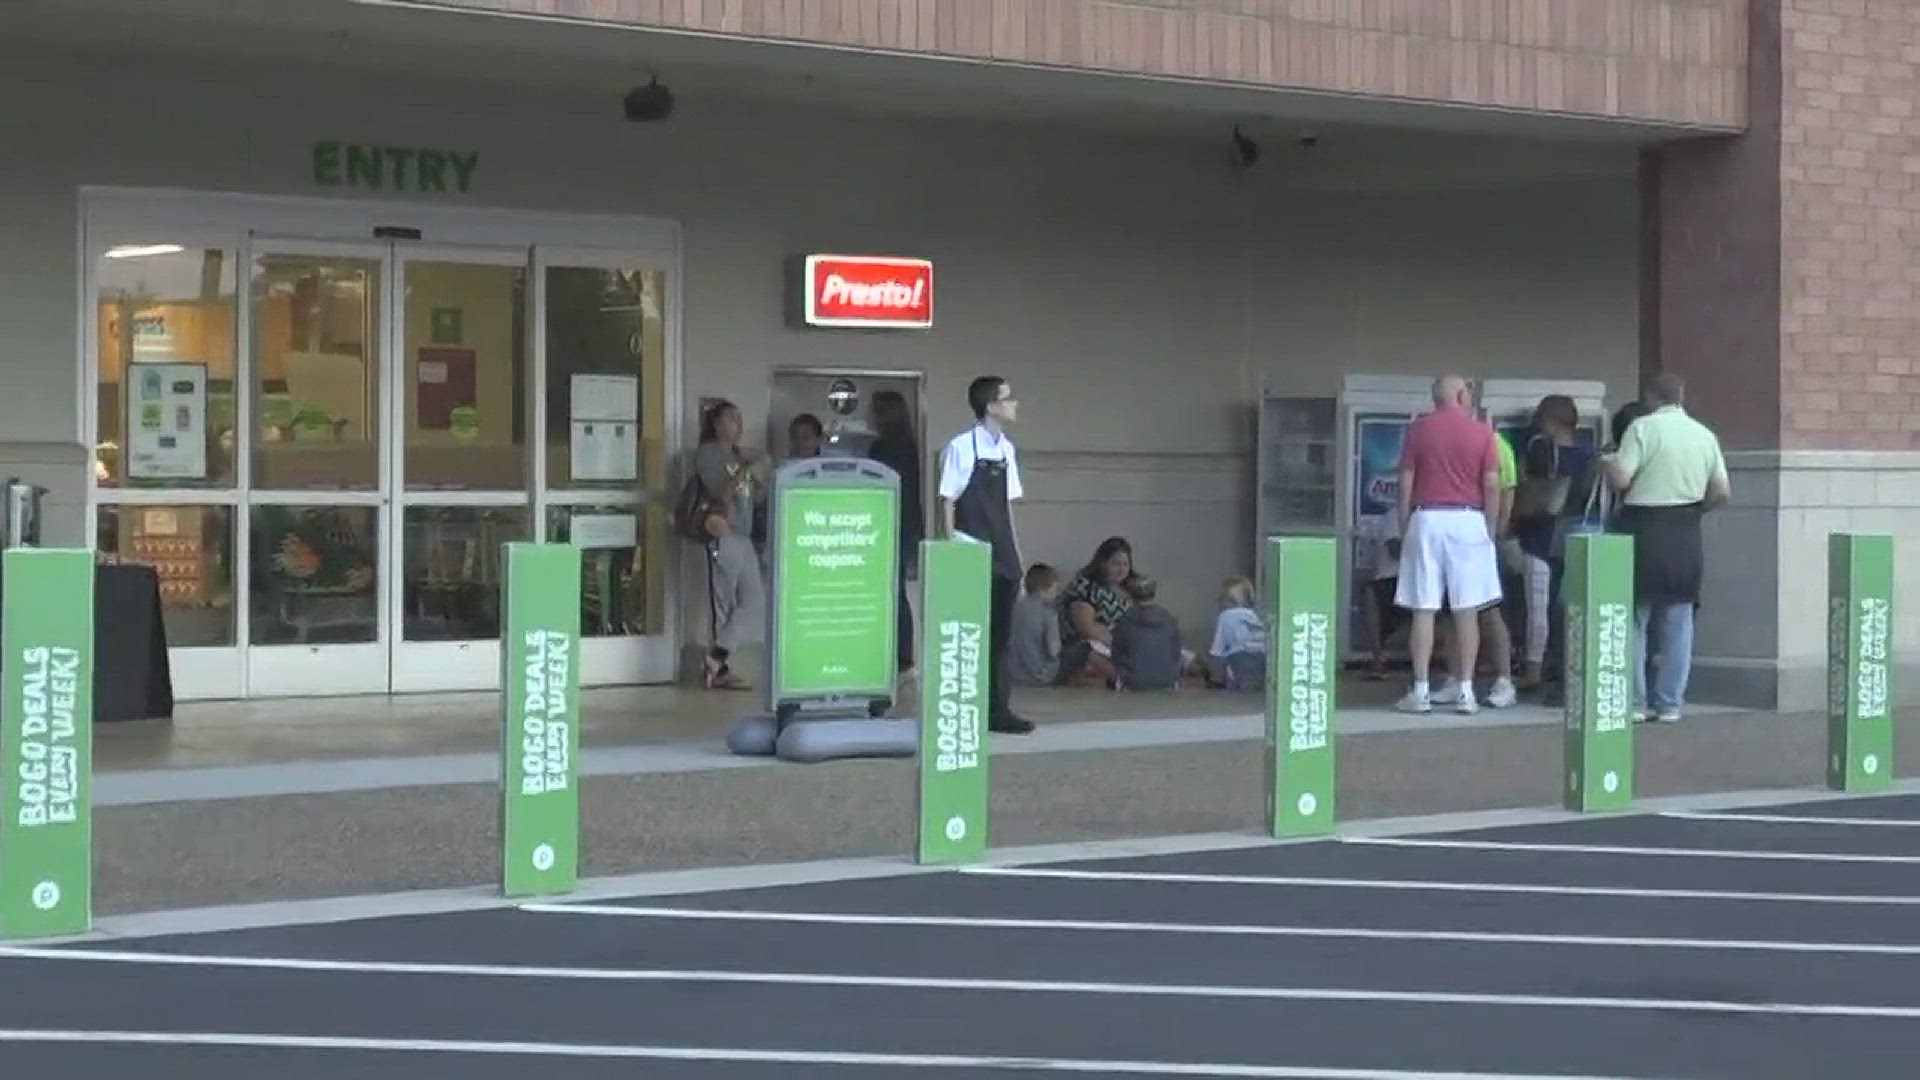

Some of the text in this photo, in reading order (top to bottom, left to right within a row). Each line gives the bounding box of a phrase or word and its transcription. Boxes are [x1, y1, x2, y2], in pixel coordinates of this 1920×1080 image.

[313, 141, 478, 192] ENTRY
[820, 273, 924, 308] Presto!
[804, 511, 872, 530] We accept
[19, 647, 49, 826] BOGO DEALS
[49, 647, 79, 823] EVERY WEEK!
[521, 629, 546, 795] BOGO DEALS
[547, 631, 569, 717] WEEK!
[937, 621, 959, 771] BOGO DEALS
[1290, 612, 1309, 753] BOGO DEALS
